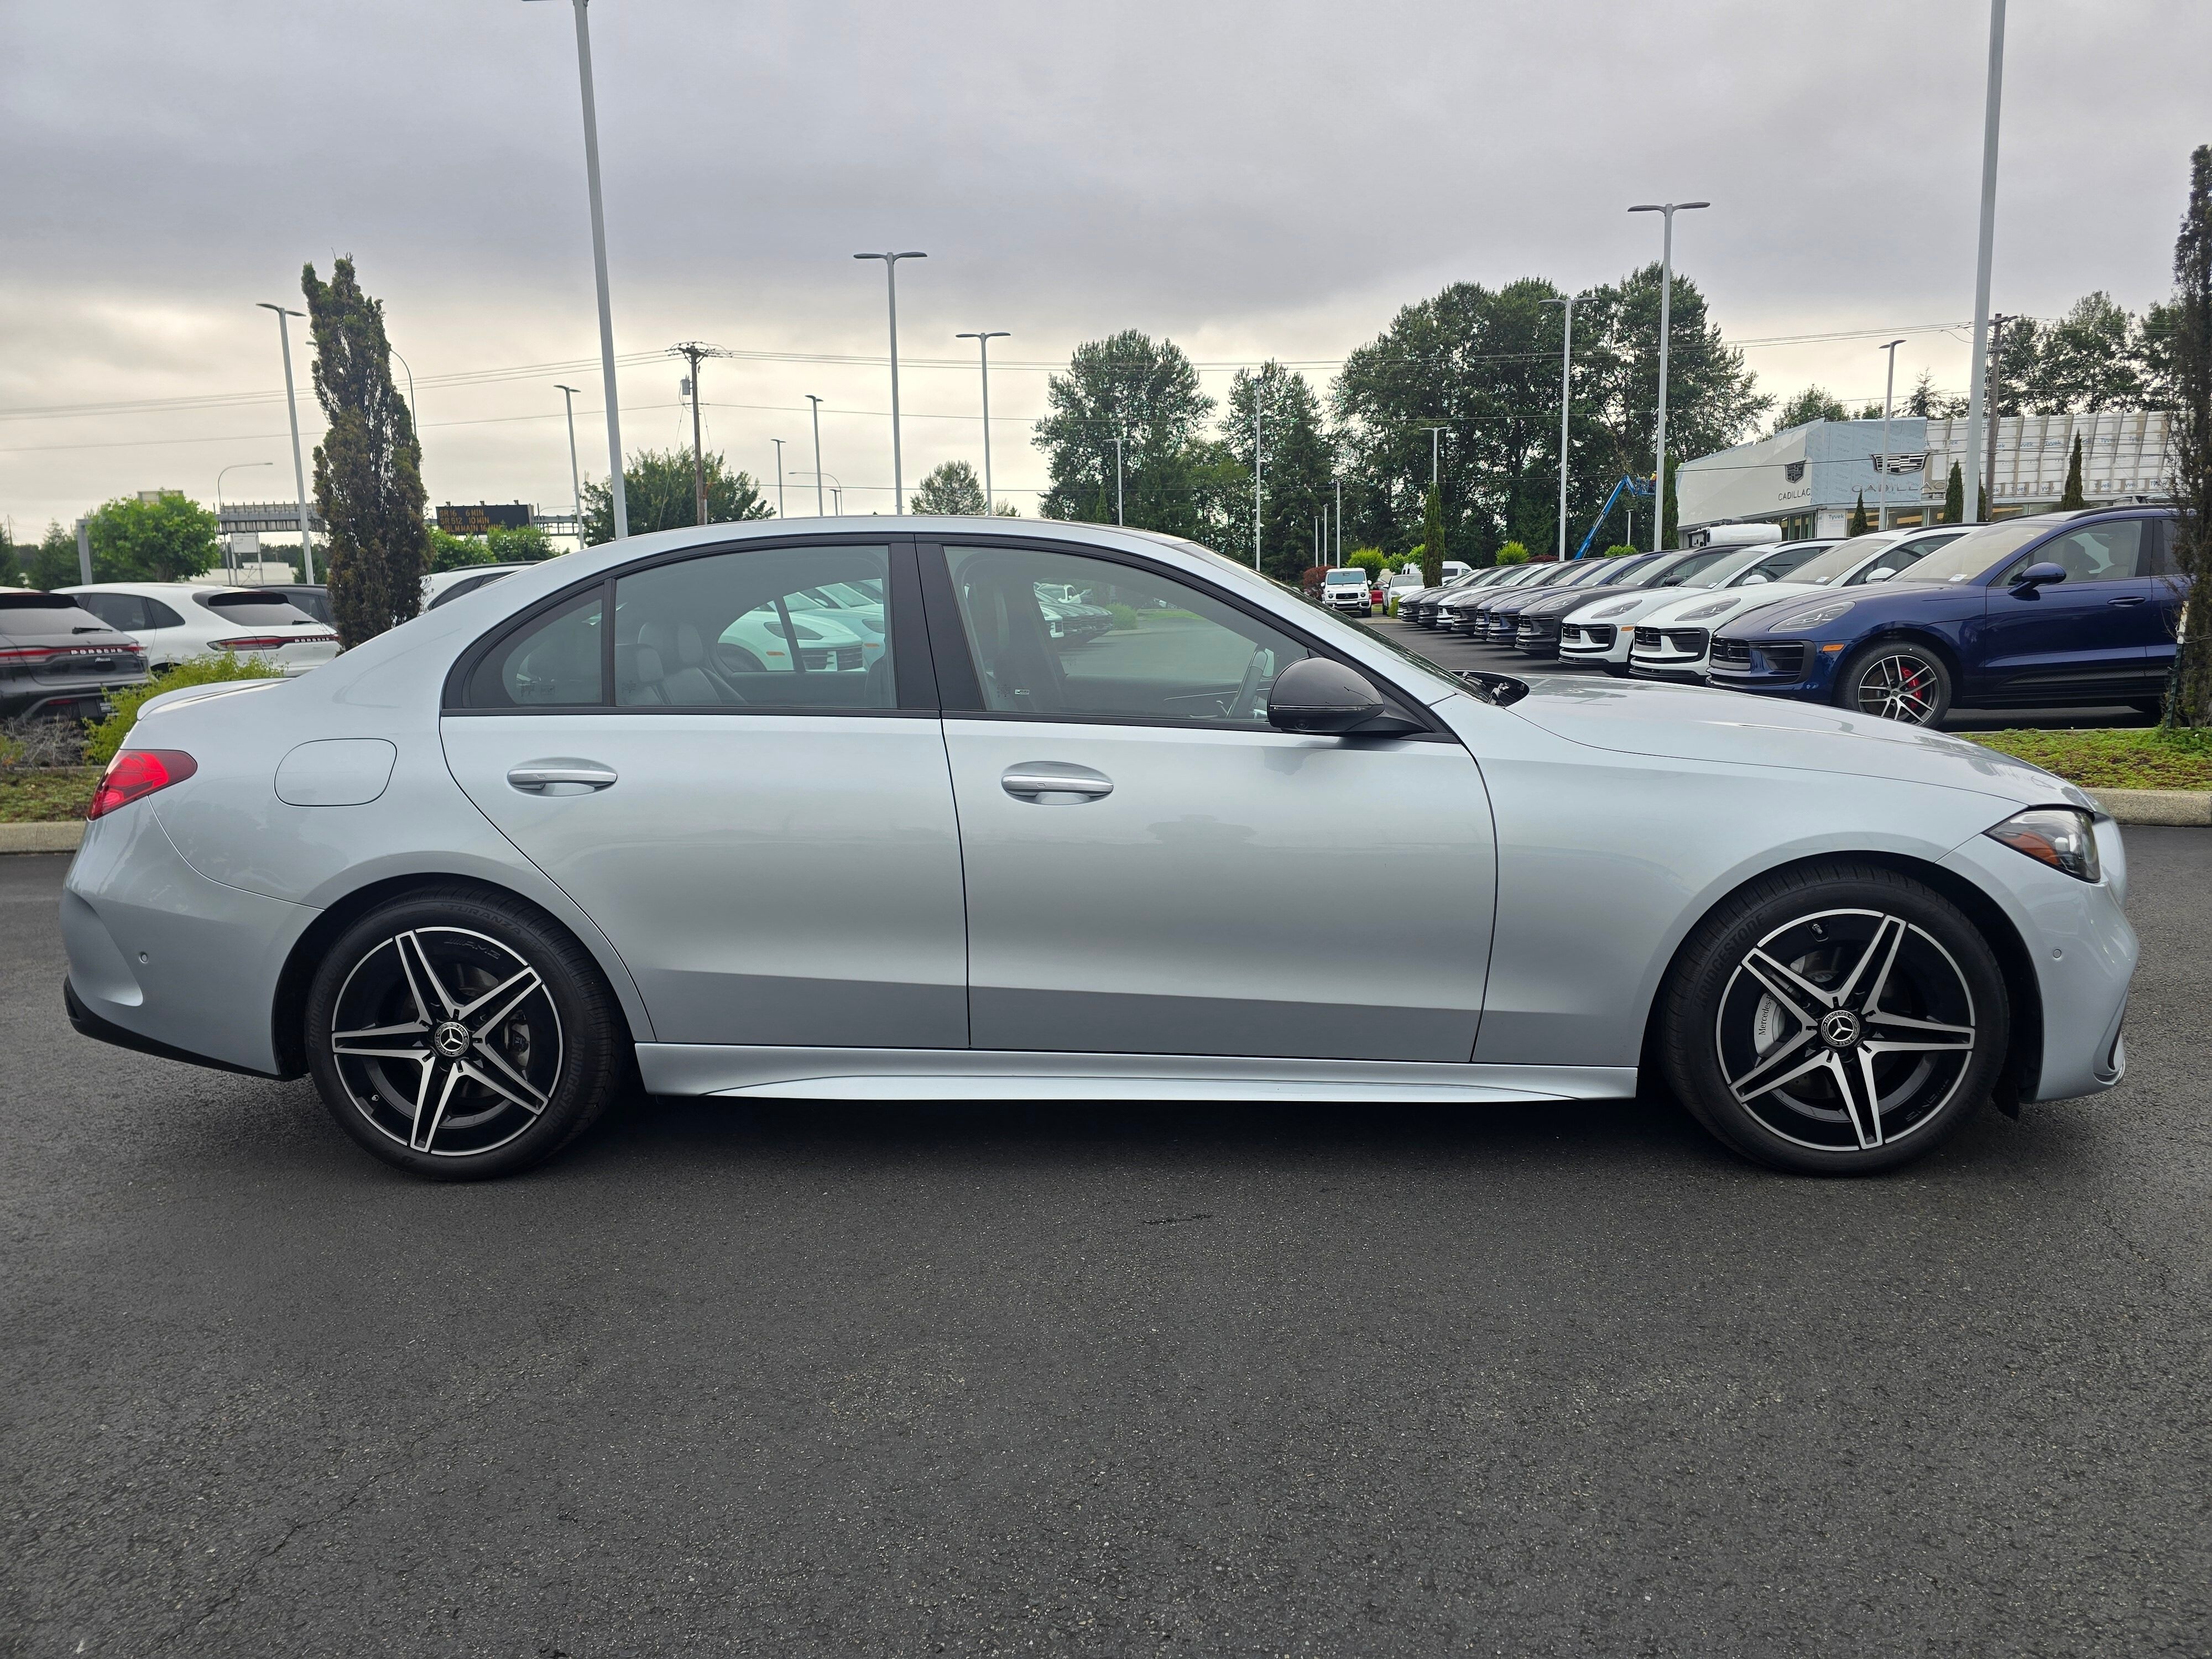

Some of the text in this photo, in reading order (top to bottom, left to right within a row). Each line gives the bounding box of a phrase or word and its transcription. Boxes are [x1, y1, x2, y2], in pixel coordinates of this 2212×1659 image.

[1851, 481, 1945, 493] CADILLAC
[1778, 488, 1811, 500] CADILLAC
[439, 508, 484, 517] SR 16 6 MIN
[447, 904, 521, 936] TURANZA
[1694, 912, 1767, 1011] BRIDGESTONE
[1759, 995, 1773, 1036] Mercedes-
[1825, 1011, 1850, 1024] MERCEDES
